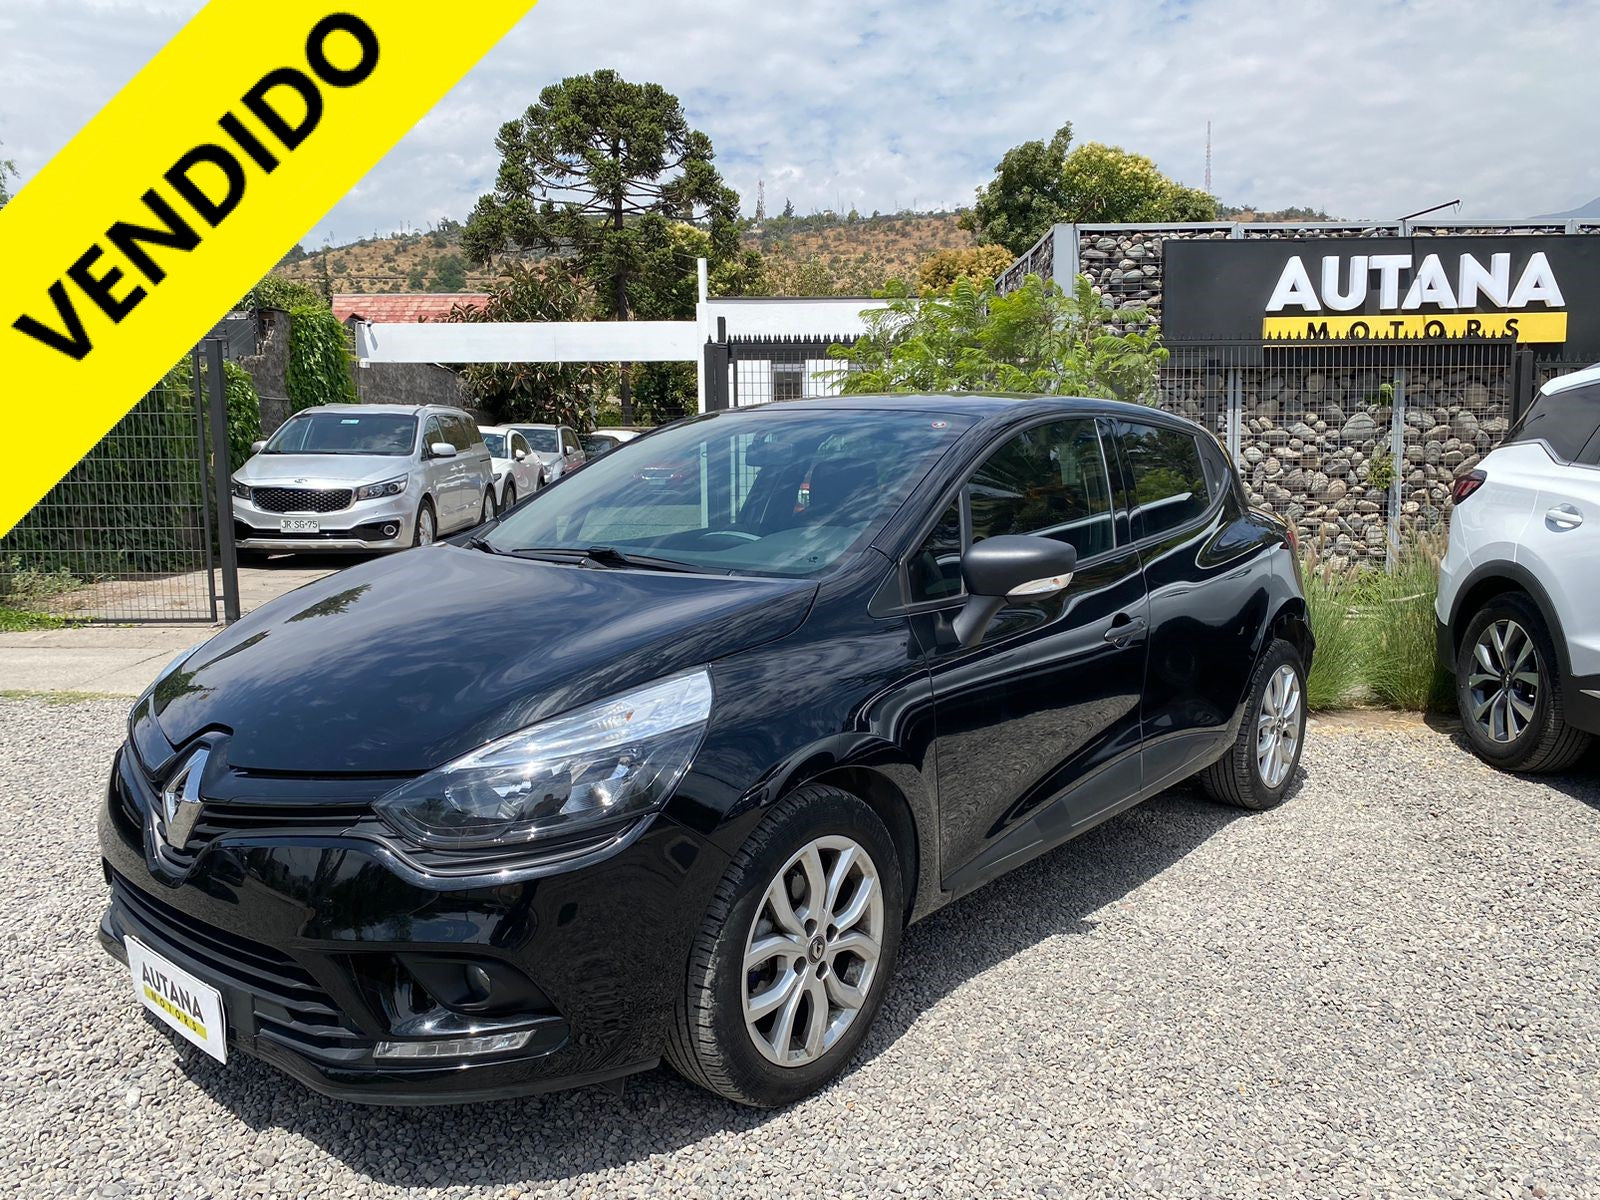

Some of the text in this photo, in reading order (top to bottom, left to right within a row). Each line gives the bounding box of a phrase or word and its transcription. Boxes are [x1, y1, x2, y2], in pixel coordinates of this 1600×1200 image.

[1266, 252, 1566, 312] AUTANA
[1307, 319, 1519, 339] MOTORS
[142, 961, 204, 1024] AUTANA
[150, 991, 197, 1032] MOTORS
